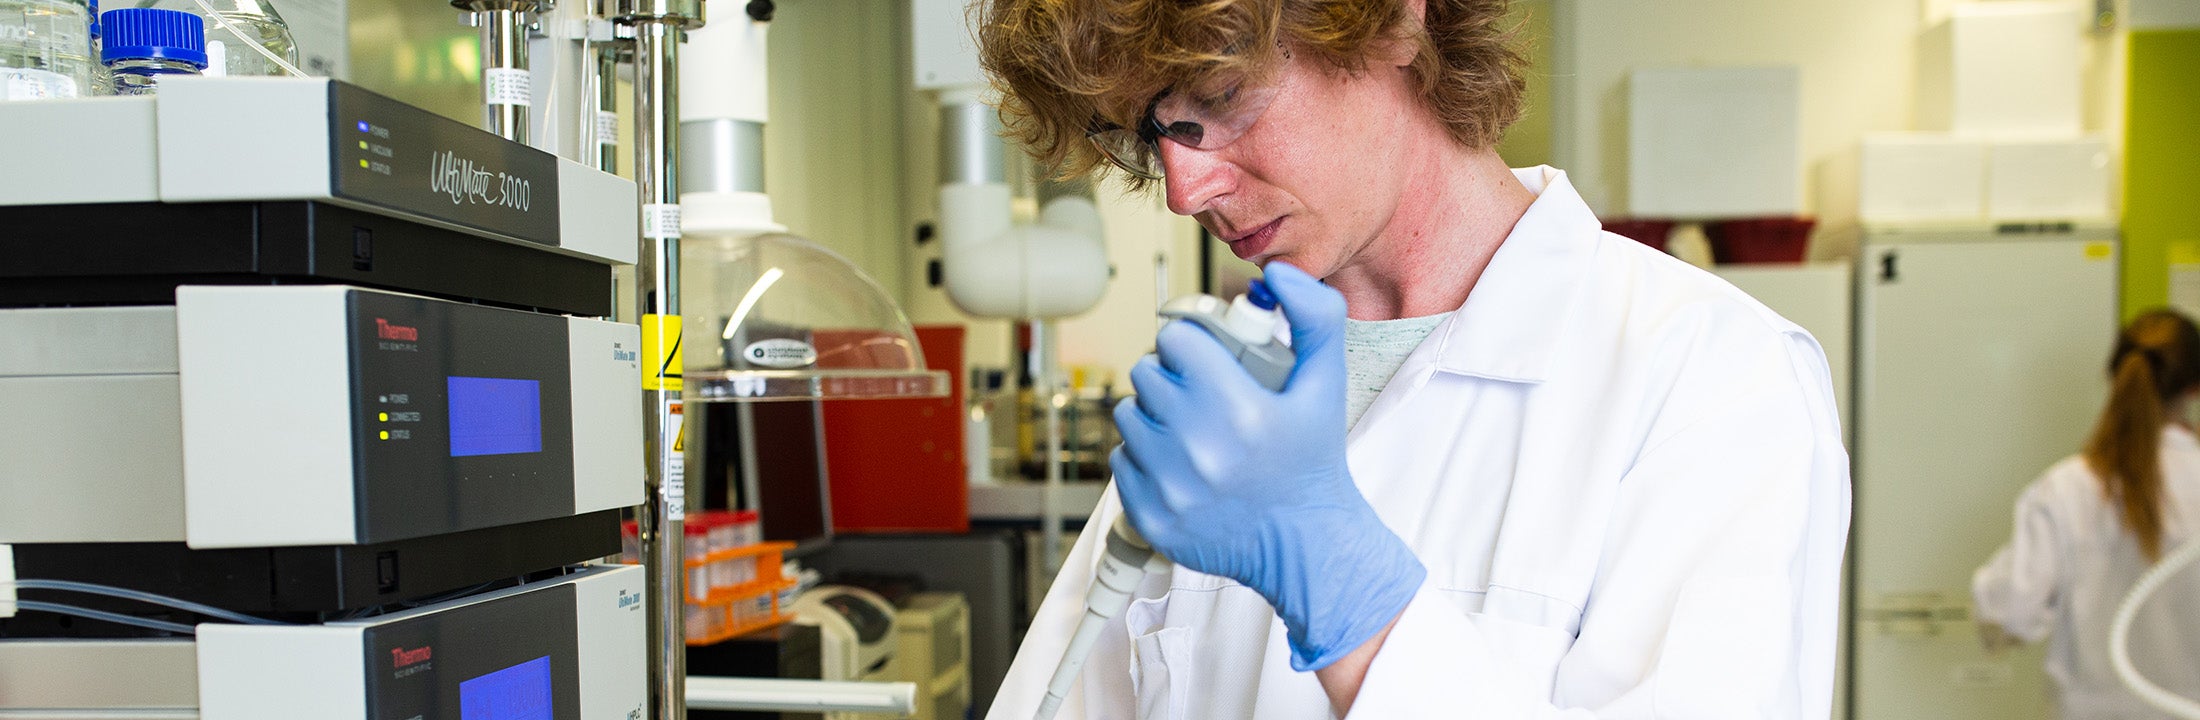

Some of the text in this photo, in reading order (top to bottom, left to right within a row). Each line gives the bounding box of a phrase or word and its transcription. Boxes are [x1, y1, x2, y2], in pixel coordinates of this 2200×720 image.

[431, 150, 531, 212] UltiMate 3000
[375, 317, 418, 341] Thermo
[392, 646, 432, 669] Thermo
